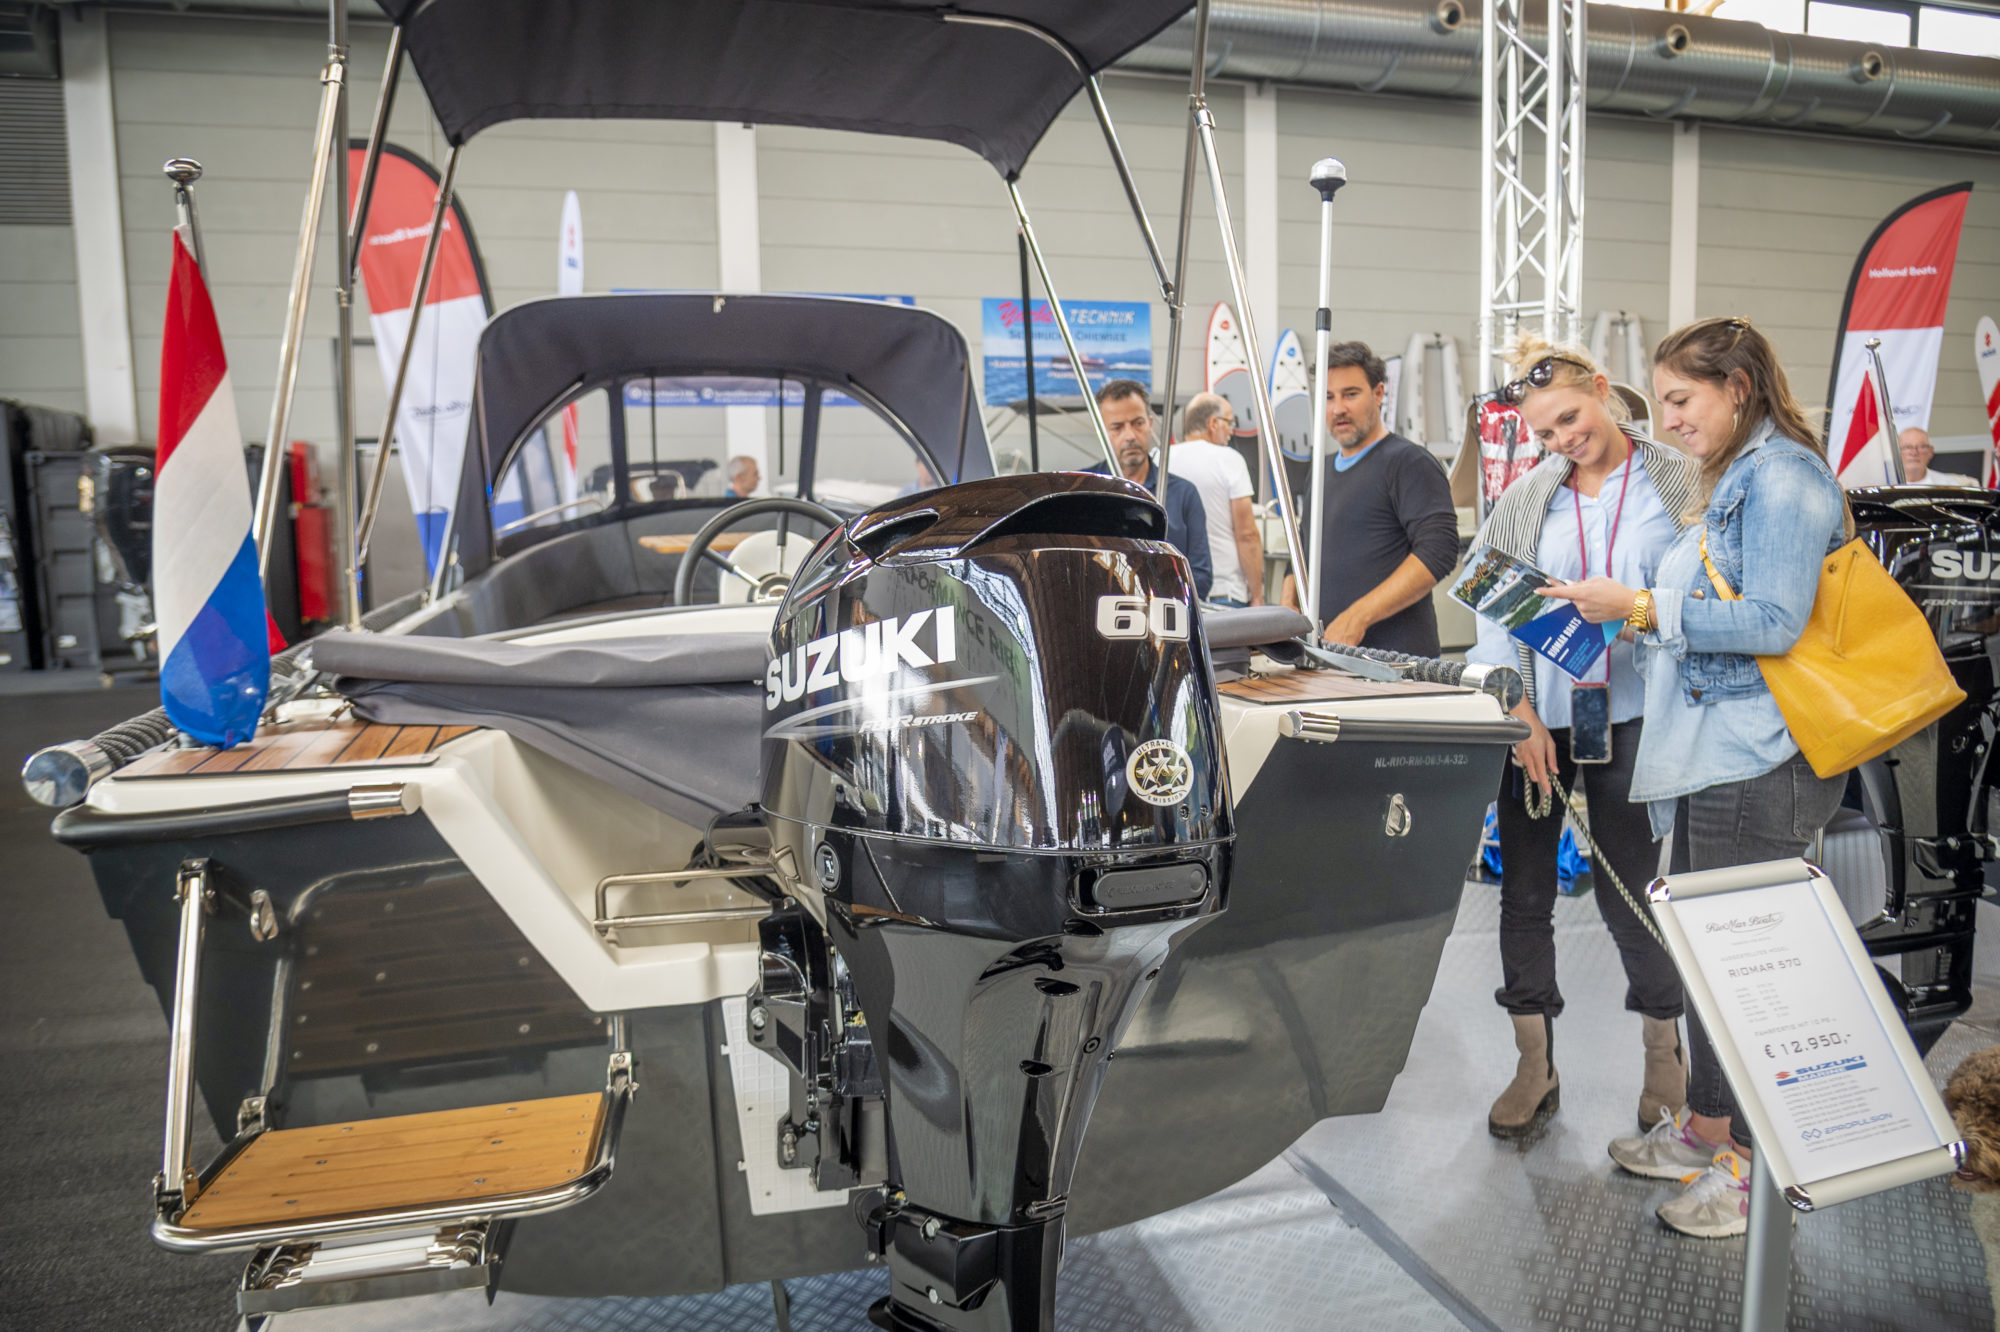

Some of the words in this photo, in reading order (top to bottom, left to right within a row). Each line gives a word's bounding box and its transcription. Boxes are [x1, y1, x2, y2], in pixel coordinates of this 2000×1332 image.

[1868, 267, 1908, 279] Holland
[1909, 265, 1938, 276] Boats
[1069, 308, 1135, 325] TECHNIK
[1097, 595, 1190, 641] 60
[1547, 633, 1569, 658] RIOMAR
[1563, 616, 1582, 638] BOATS
[766, 605, 957, 711] SUZUKI
[1727, 962, 1775, 978] RIOMAR
[1778, 957, 1802, 969] 570
[1765, 1044, 1776, 1058] €
[1780, 1032, 1851, 1056] 12.950,-
[1795, 1054, 1865, 1075] SUZUKI
